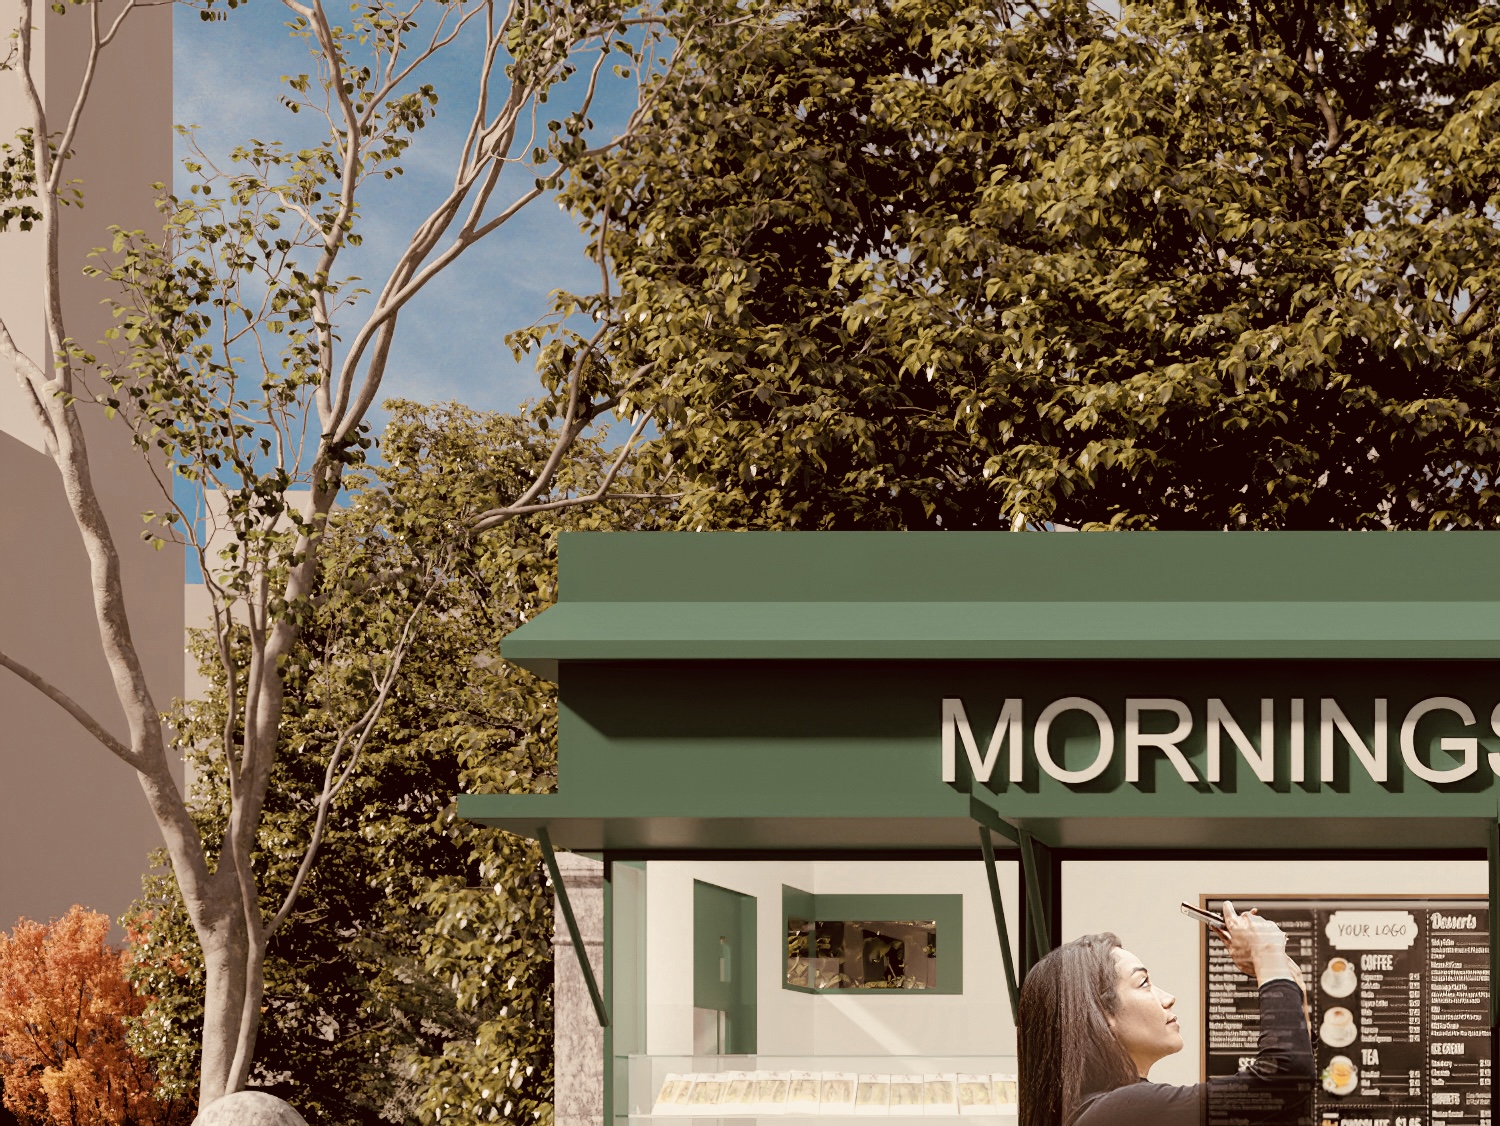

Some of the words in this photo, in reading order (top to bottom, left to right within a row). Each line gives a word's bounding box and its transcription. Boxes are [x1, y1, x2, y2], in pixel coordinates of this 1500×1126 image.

[1430, 912, 1477, 930] Desserts
[1338, 924, 1370, 937] YOUR
[1375, 924, 1407, 937] LOGO
[1360, 954, 1394, 971] COFFEE
[1361, 1048, 1380, 1066] TEA
